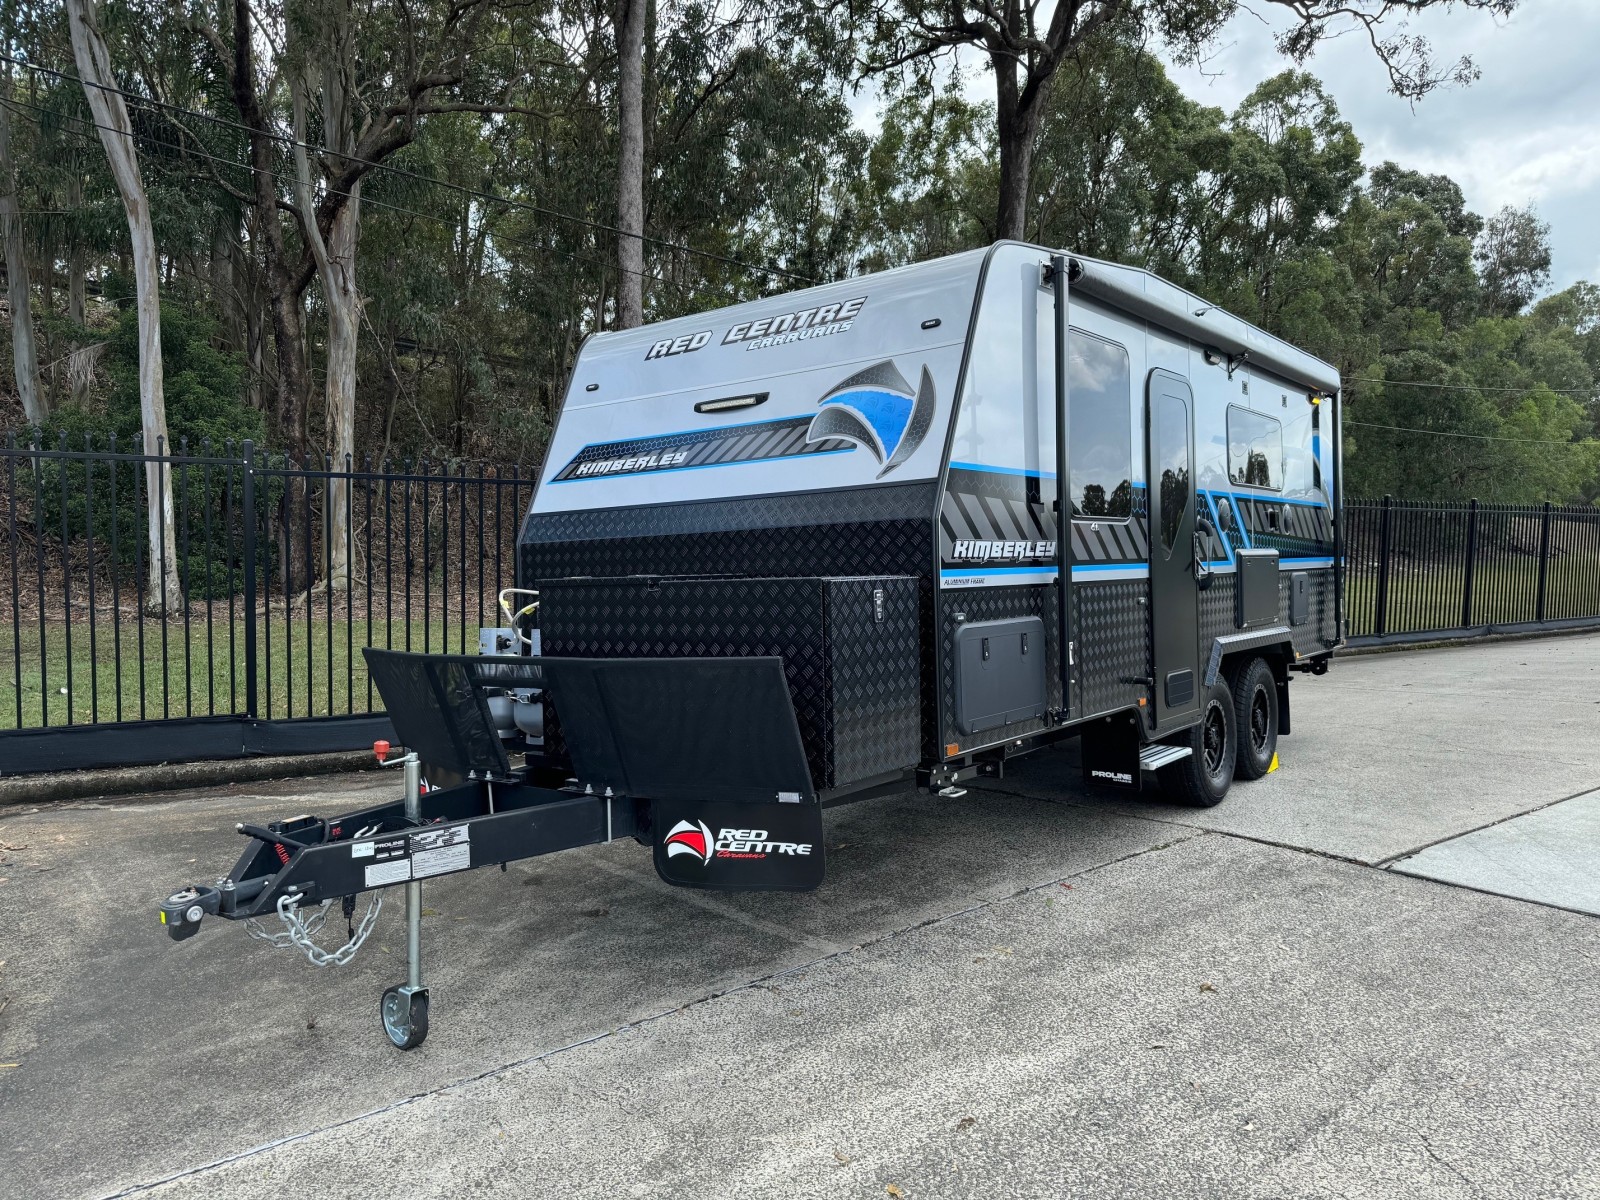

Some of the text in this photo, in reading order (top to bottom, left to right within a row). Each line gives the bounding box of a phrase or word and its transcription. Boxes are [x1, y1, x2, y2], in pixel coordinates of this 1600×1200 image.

[644, 296, 868, 361] RED CENTRE
[746, 320, 854, 351] CARAVANS
[576, 452, 688, 475] KIMBERLEY
[951, 539, 1056, 563] KIMBERLEY
[1091, 770, 1132, 781] PROLINE
[718, 828, 769, 842] RED
[375, 840, 404, 848] PROLINE
[715, 840, 813, 856] CENTRE
[716, 850, 767, 860] Caravans
